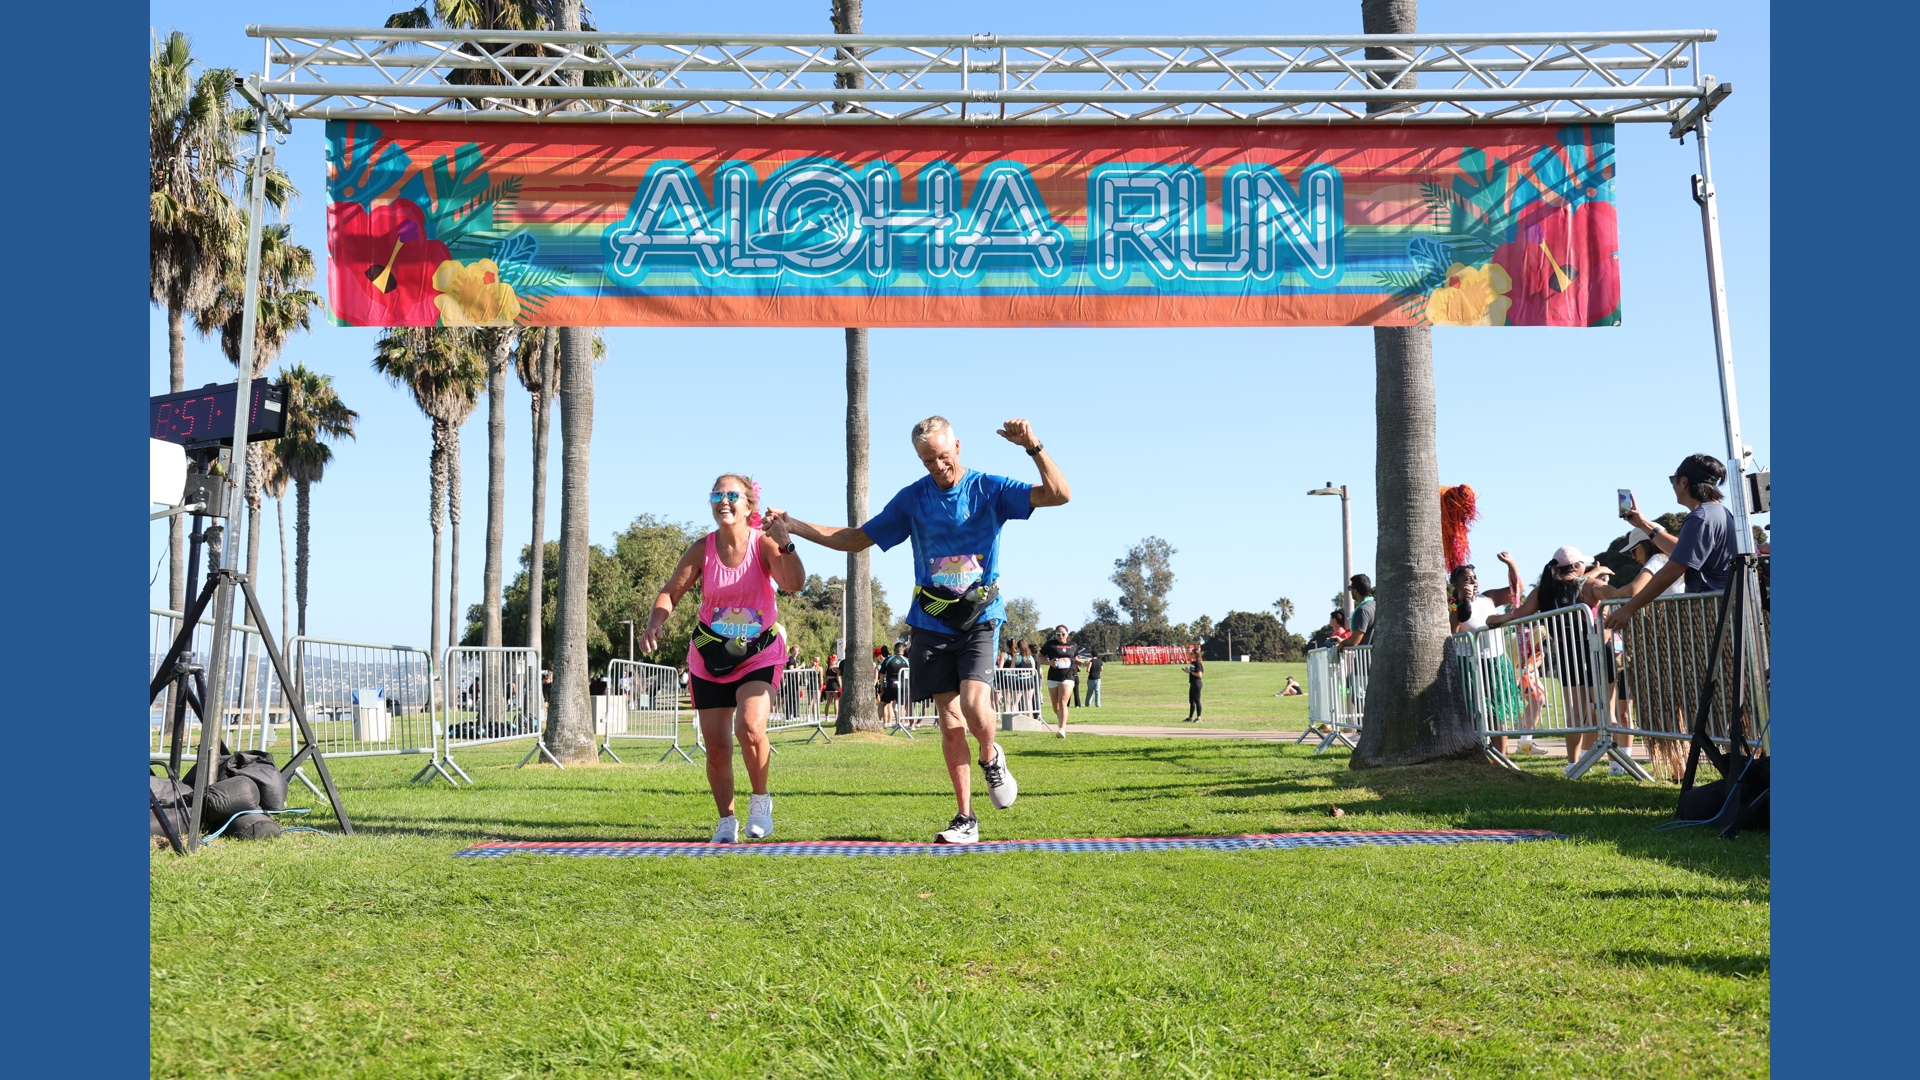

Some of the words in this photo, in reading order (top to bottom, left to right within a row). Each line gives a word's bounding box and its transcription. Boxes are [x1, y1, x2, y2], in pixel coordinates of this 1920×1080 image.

[607, 163, 1065, 279] ALOHA
[1093, 165, 1339, 280] RUN
[943, 572, 971, 586] 2205
[721, 622, 748, 636] 2319
